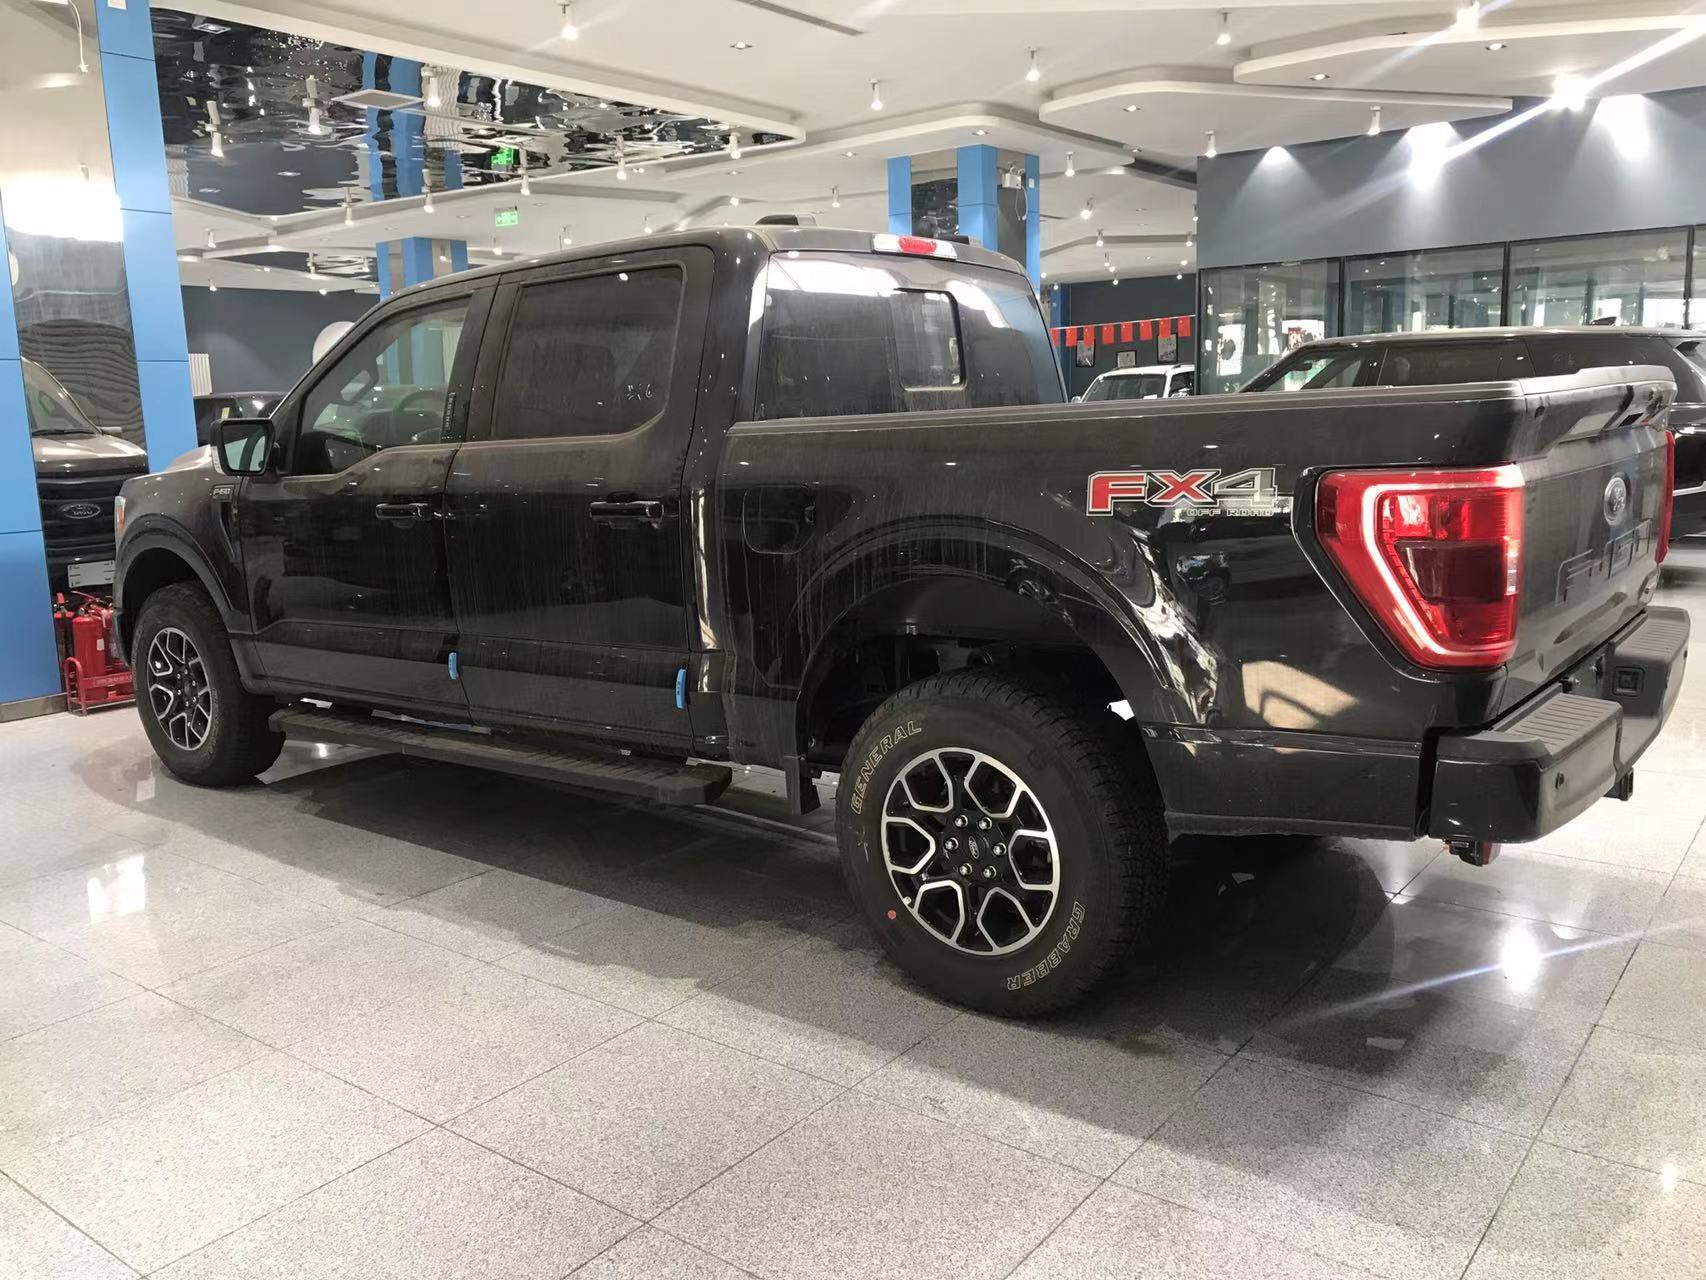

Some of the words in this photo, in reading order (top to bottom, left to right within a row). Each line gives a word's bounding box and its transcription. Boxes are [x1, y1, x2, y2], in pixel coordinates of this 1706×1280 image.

[1087, 467, 1277, 516] FX4
[1186, 507, 1221, 517] OFF
[1227, 507, 1275, 517] ROAD
[850, 720, 922, 815] GENERAL
[1006, 900, 1086, 991] GRABBER
